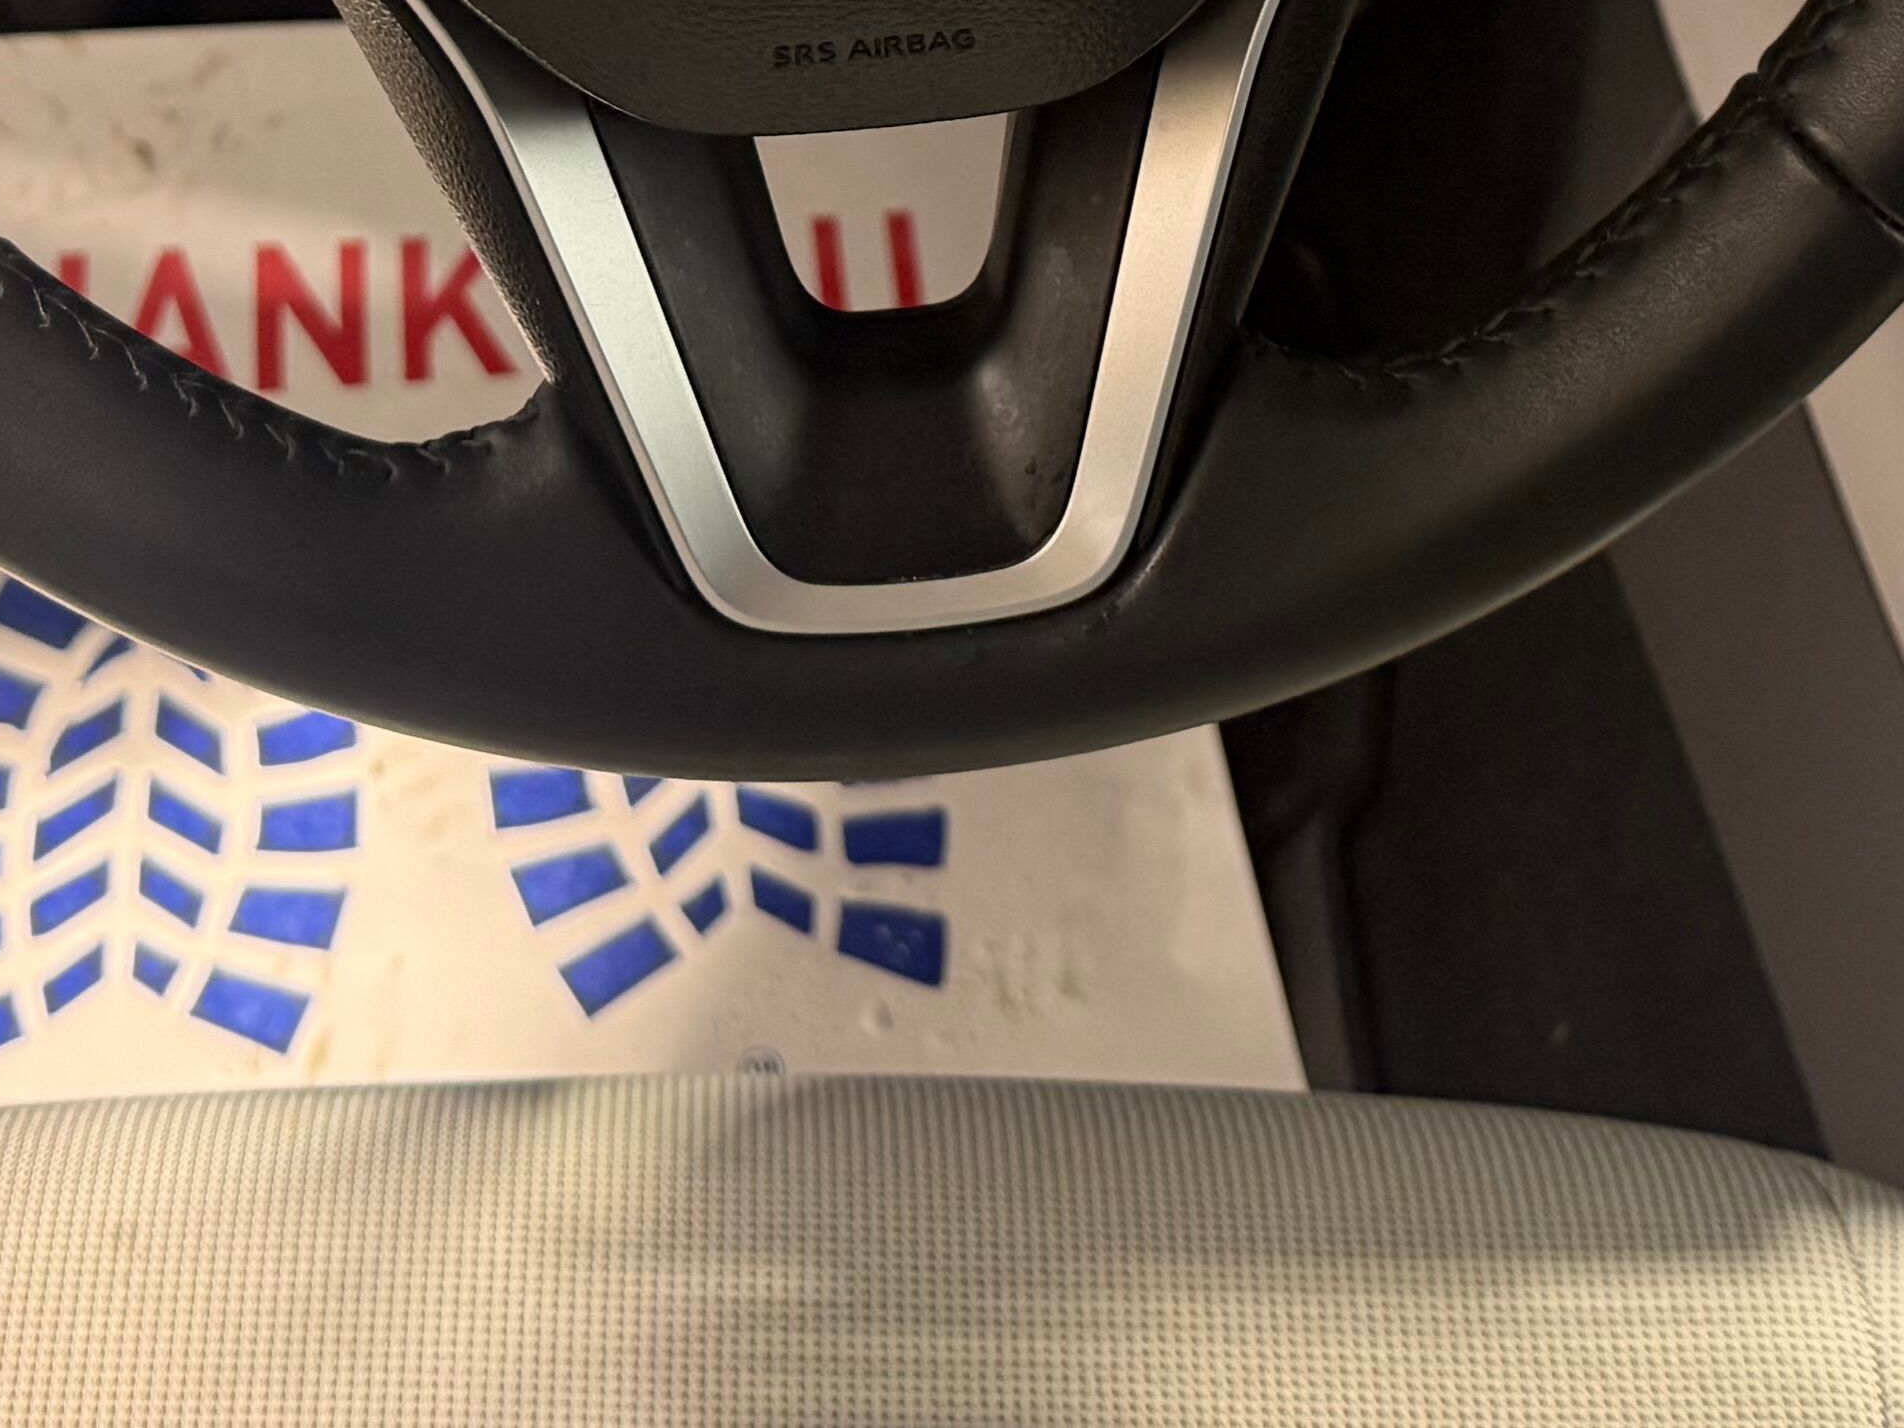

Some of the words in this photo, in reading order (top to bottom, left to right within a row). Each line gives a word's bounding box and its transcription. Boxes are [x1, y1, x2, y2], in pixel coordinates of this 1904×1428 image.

[772, 41, 838, 69] SRS
[847, 27, 977, 62] AIRBAG
[62, 235, 518, 393] ANK
